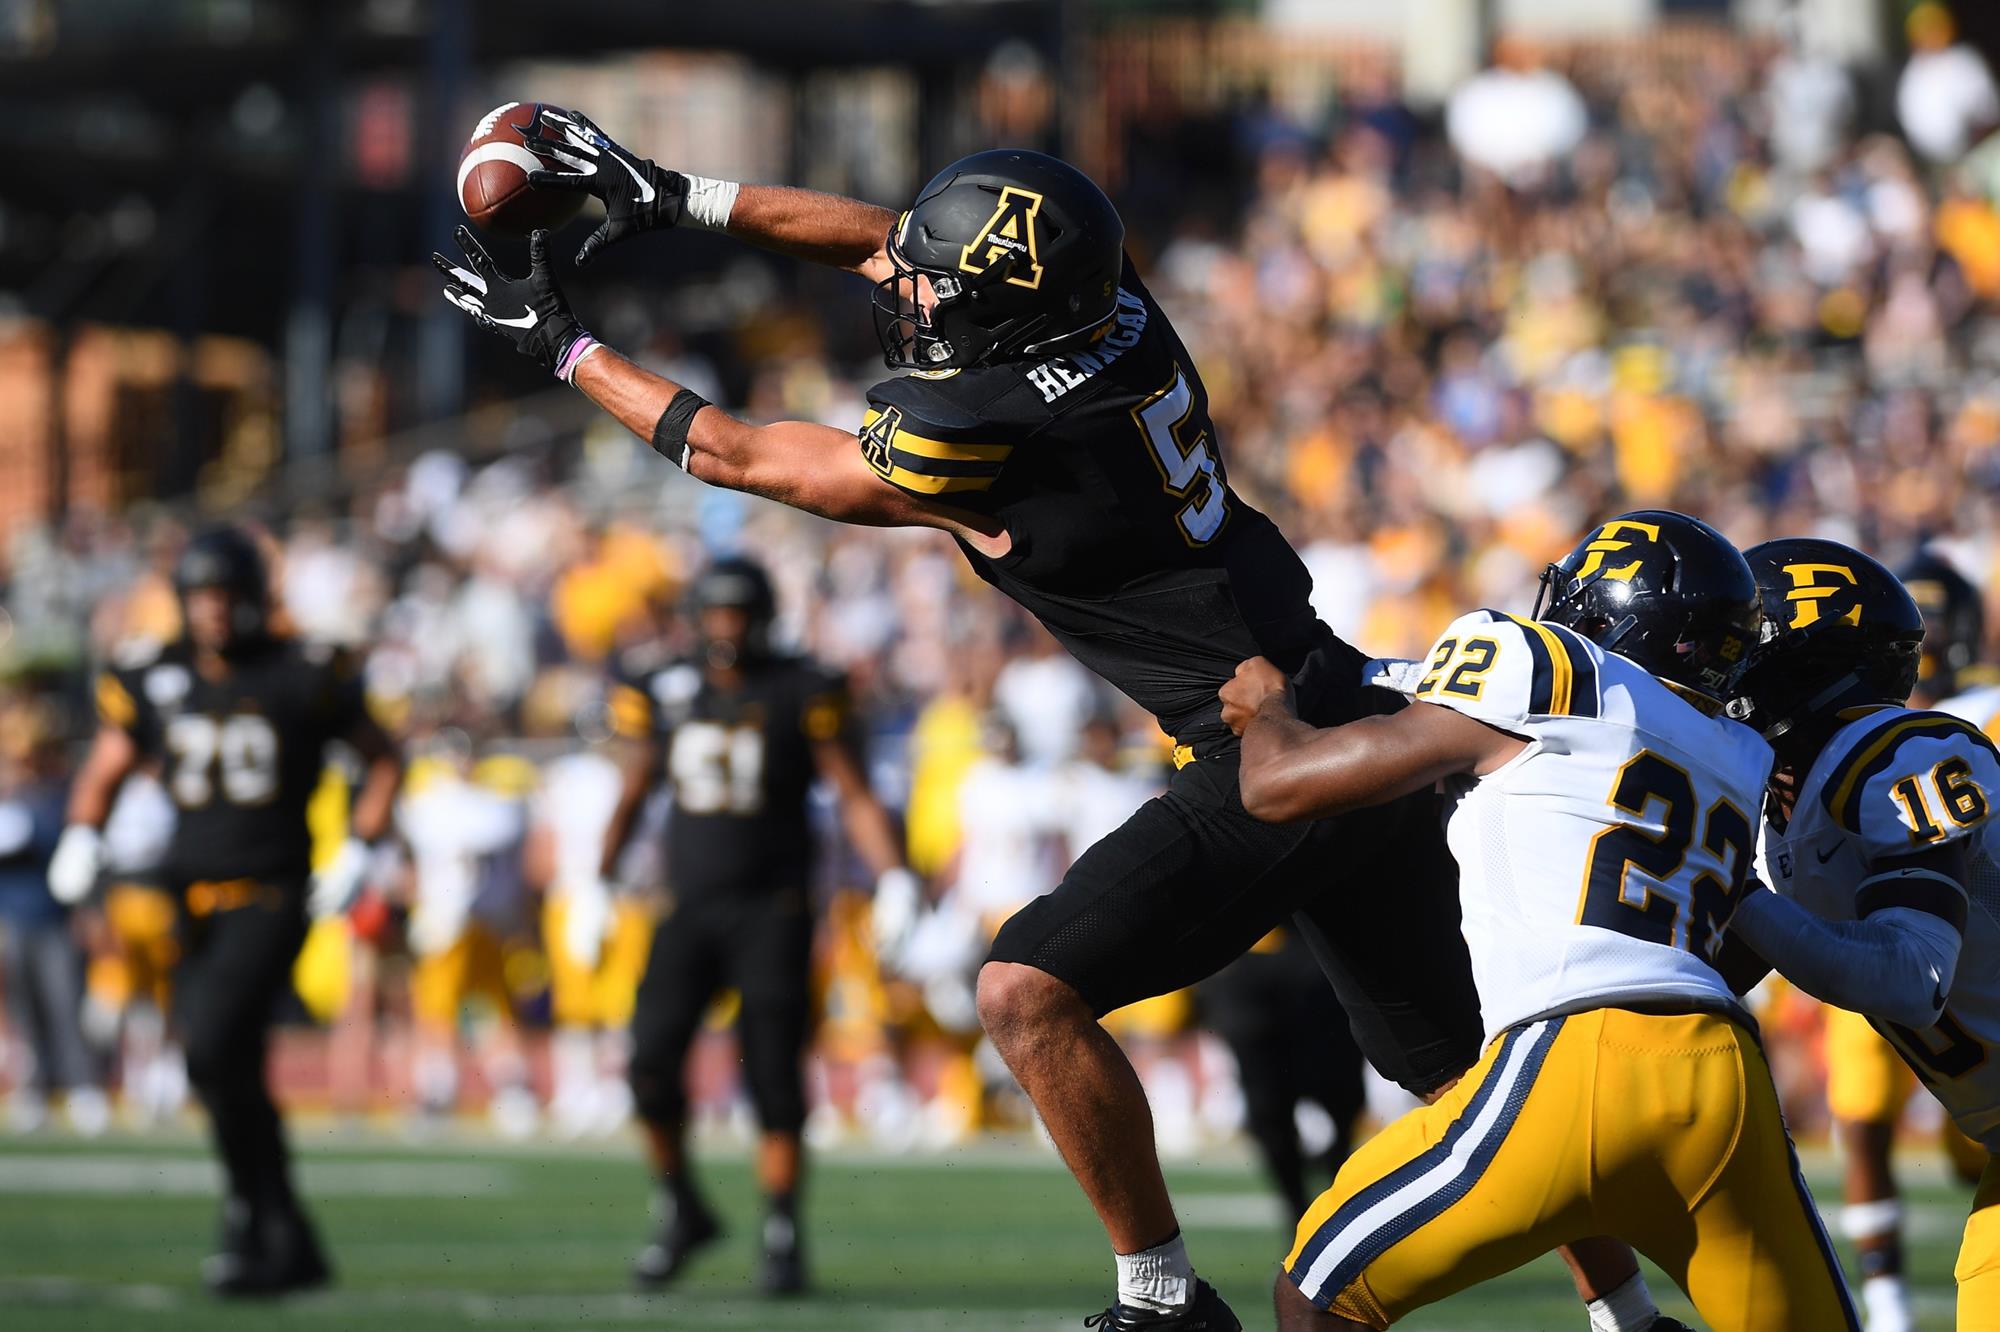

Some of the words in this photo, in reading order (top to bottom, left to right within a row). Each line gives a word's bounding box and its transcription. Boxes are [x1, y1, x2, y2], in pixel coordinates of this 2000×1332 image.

[1130, 360, 1231, 548] 5
[1416, 636, 1501, 702] 22
[1574, 748, 1753, 961] 22
[1891, 755, 1990, 846] 16
